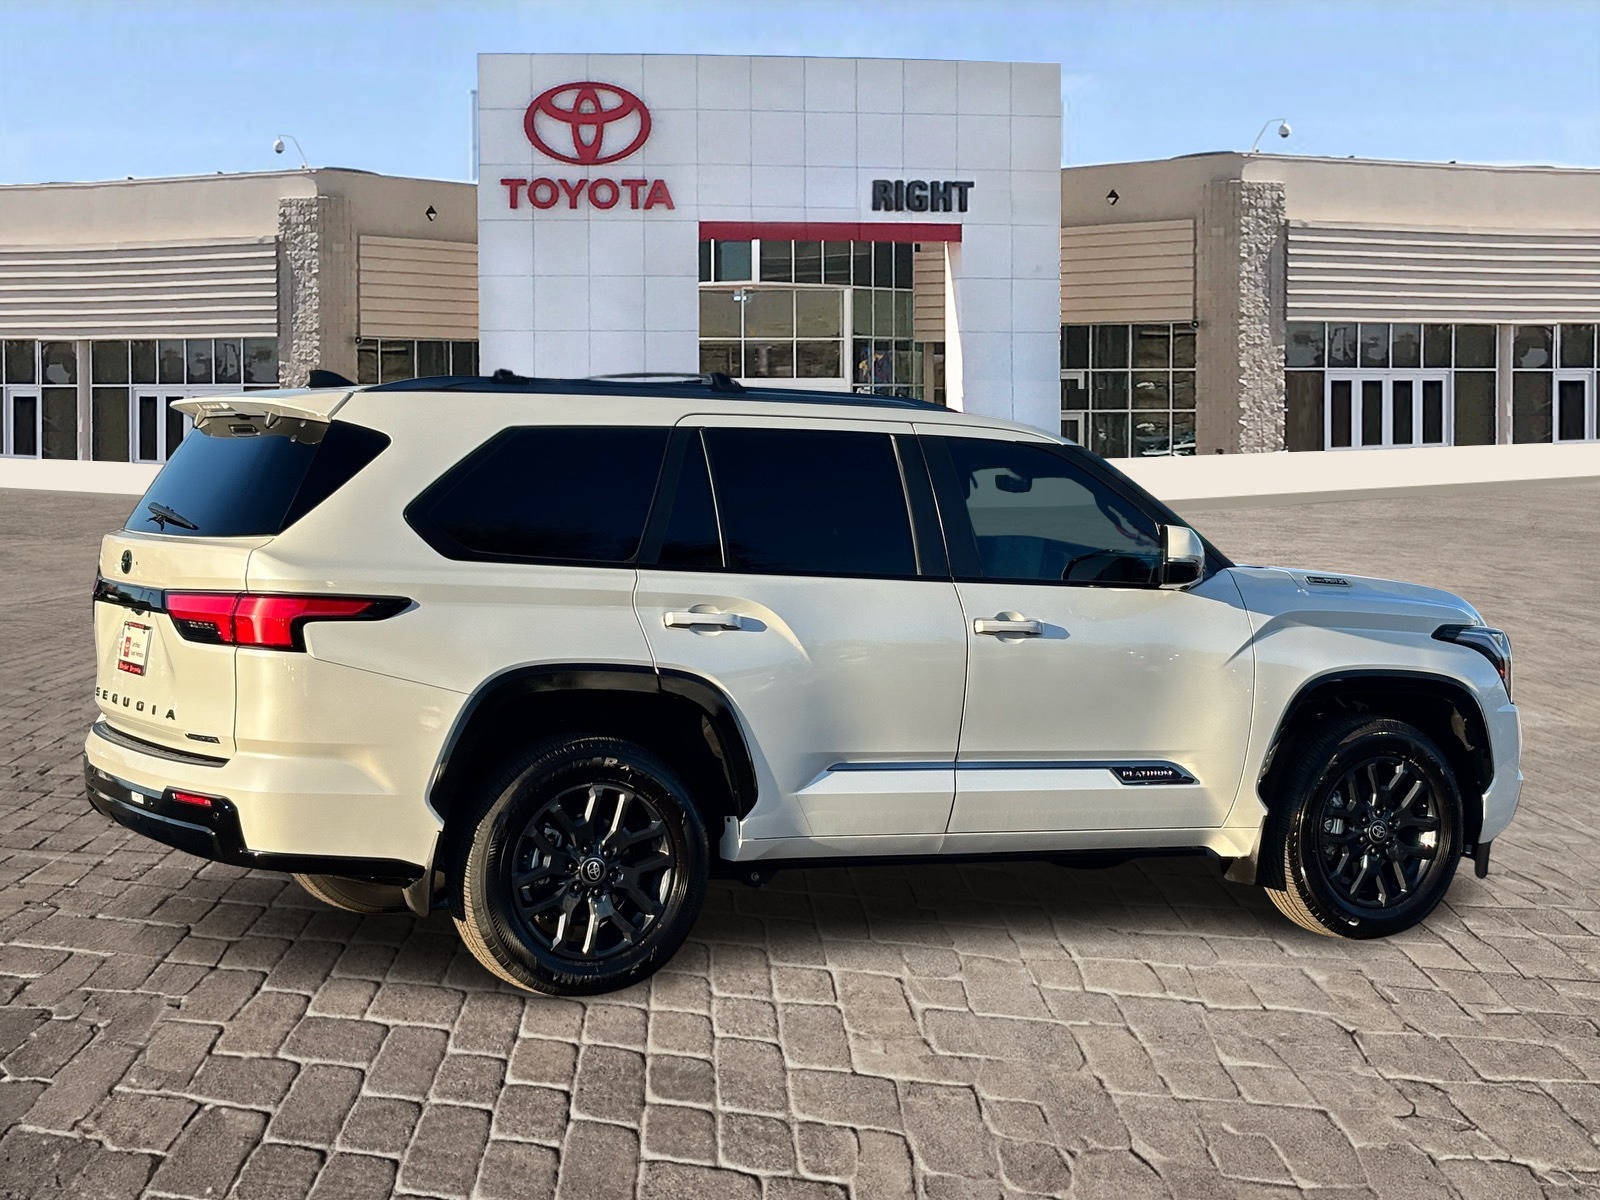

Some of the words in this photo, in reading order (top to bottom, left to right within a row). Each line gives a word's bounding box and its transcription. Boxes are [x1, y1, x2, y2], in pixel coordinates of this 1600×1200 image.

[500, 177, 676, 210] TOYOTA
[871, 179, 975, 212] RIGHT
[95, 686, 176, 721] SEQUOIA
